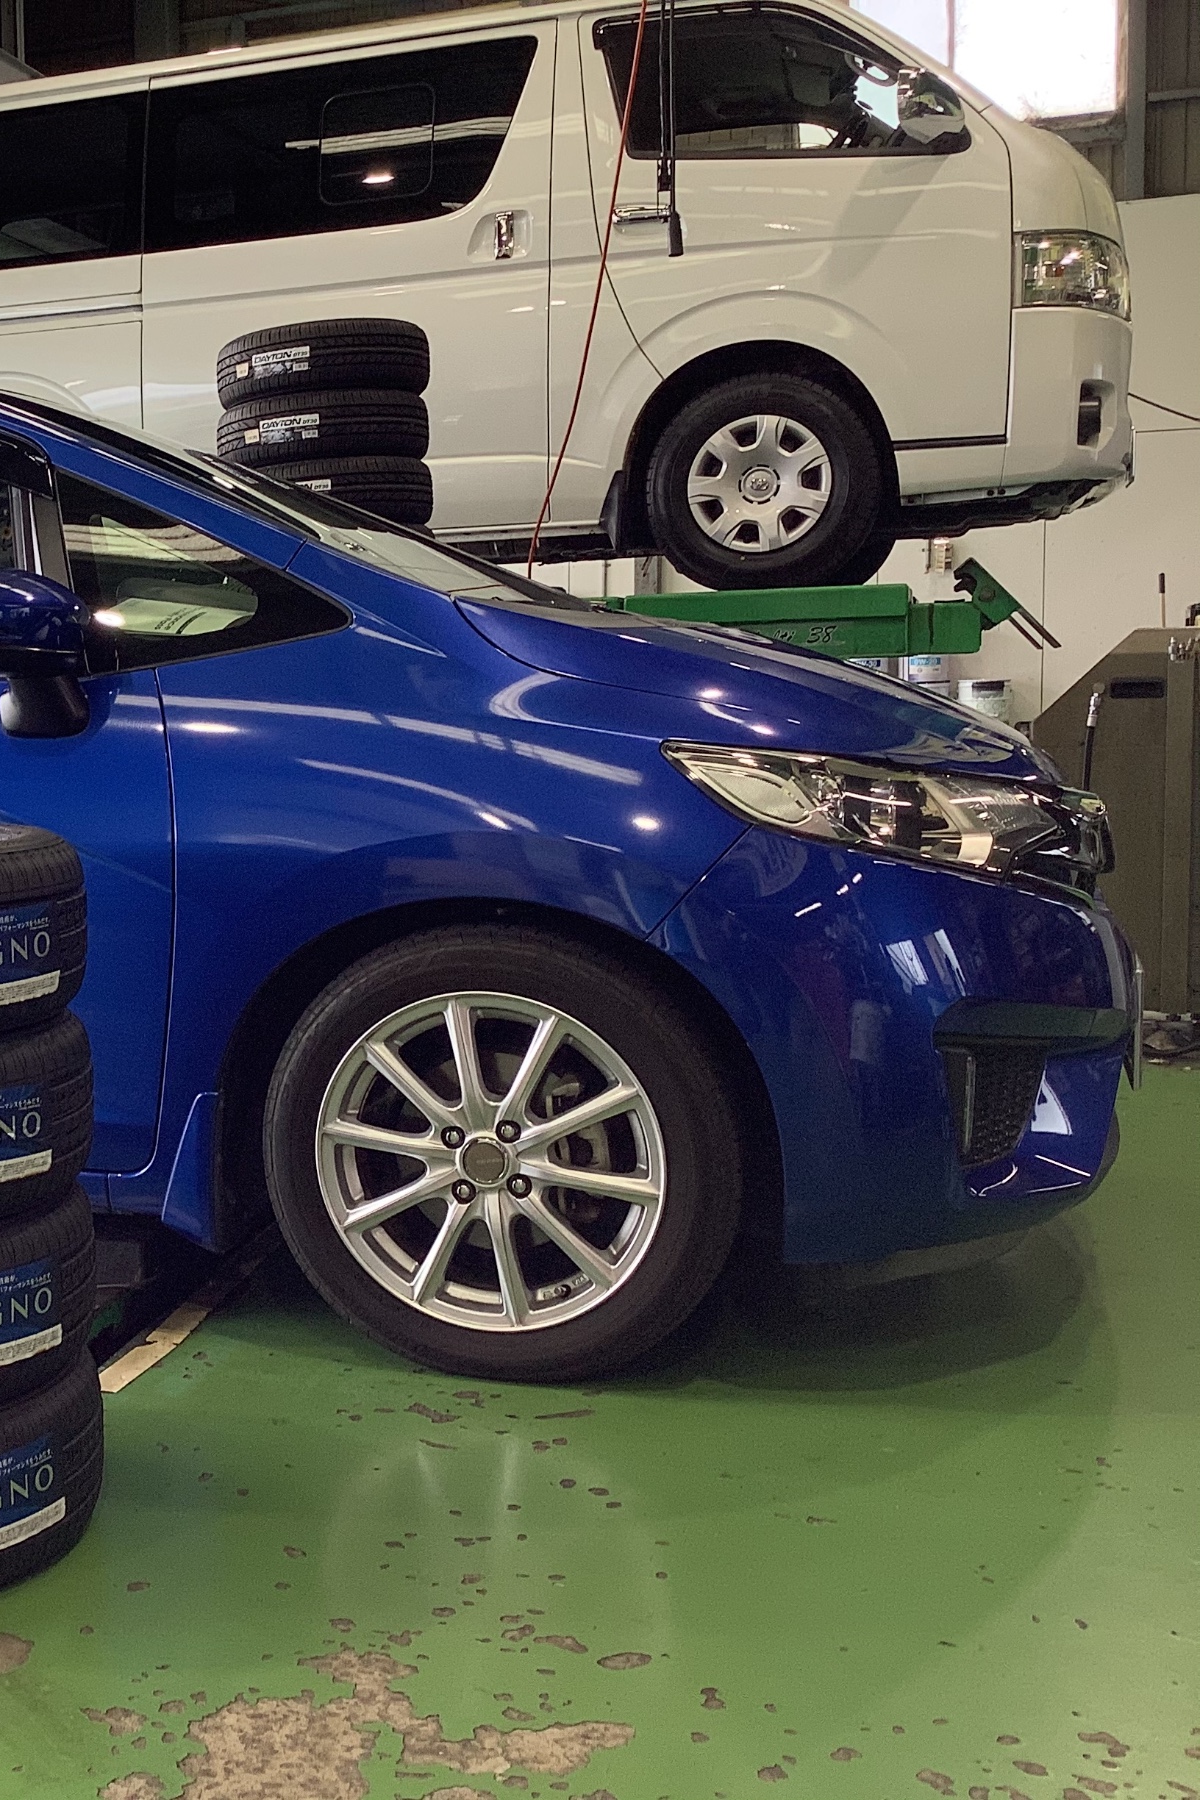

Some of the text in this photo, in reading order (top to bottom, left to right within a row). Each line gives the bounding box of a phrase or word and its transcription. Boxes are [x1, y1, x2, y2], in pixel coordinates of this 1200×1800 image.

[254, 350, 292, 364] DAYTON
[262, 417, 302, 430] DAYTON
[806, 625, 837, 644] 38
